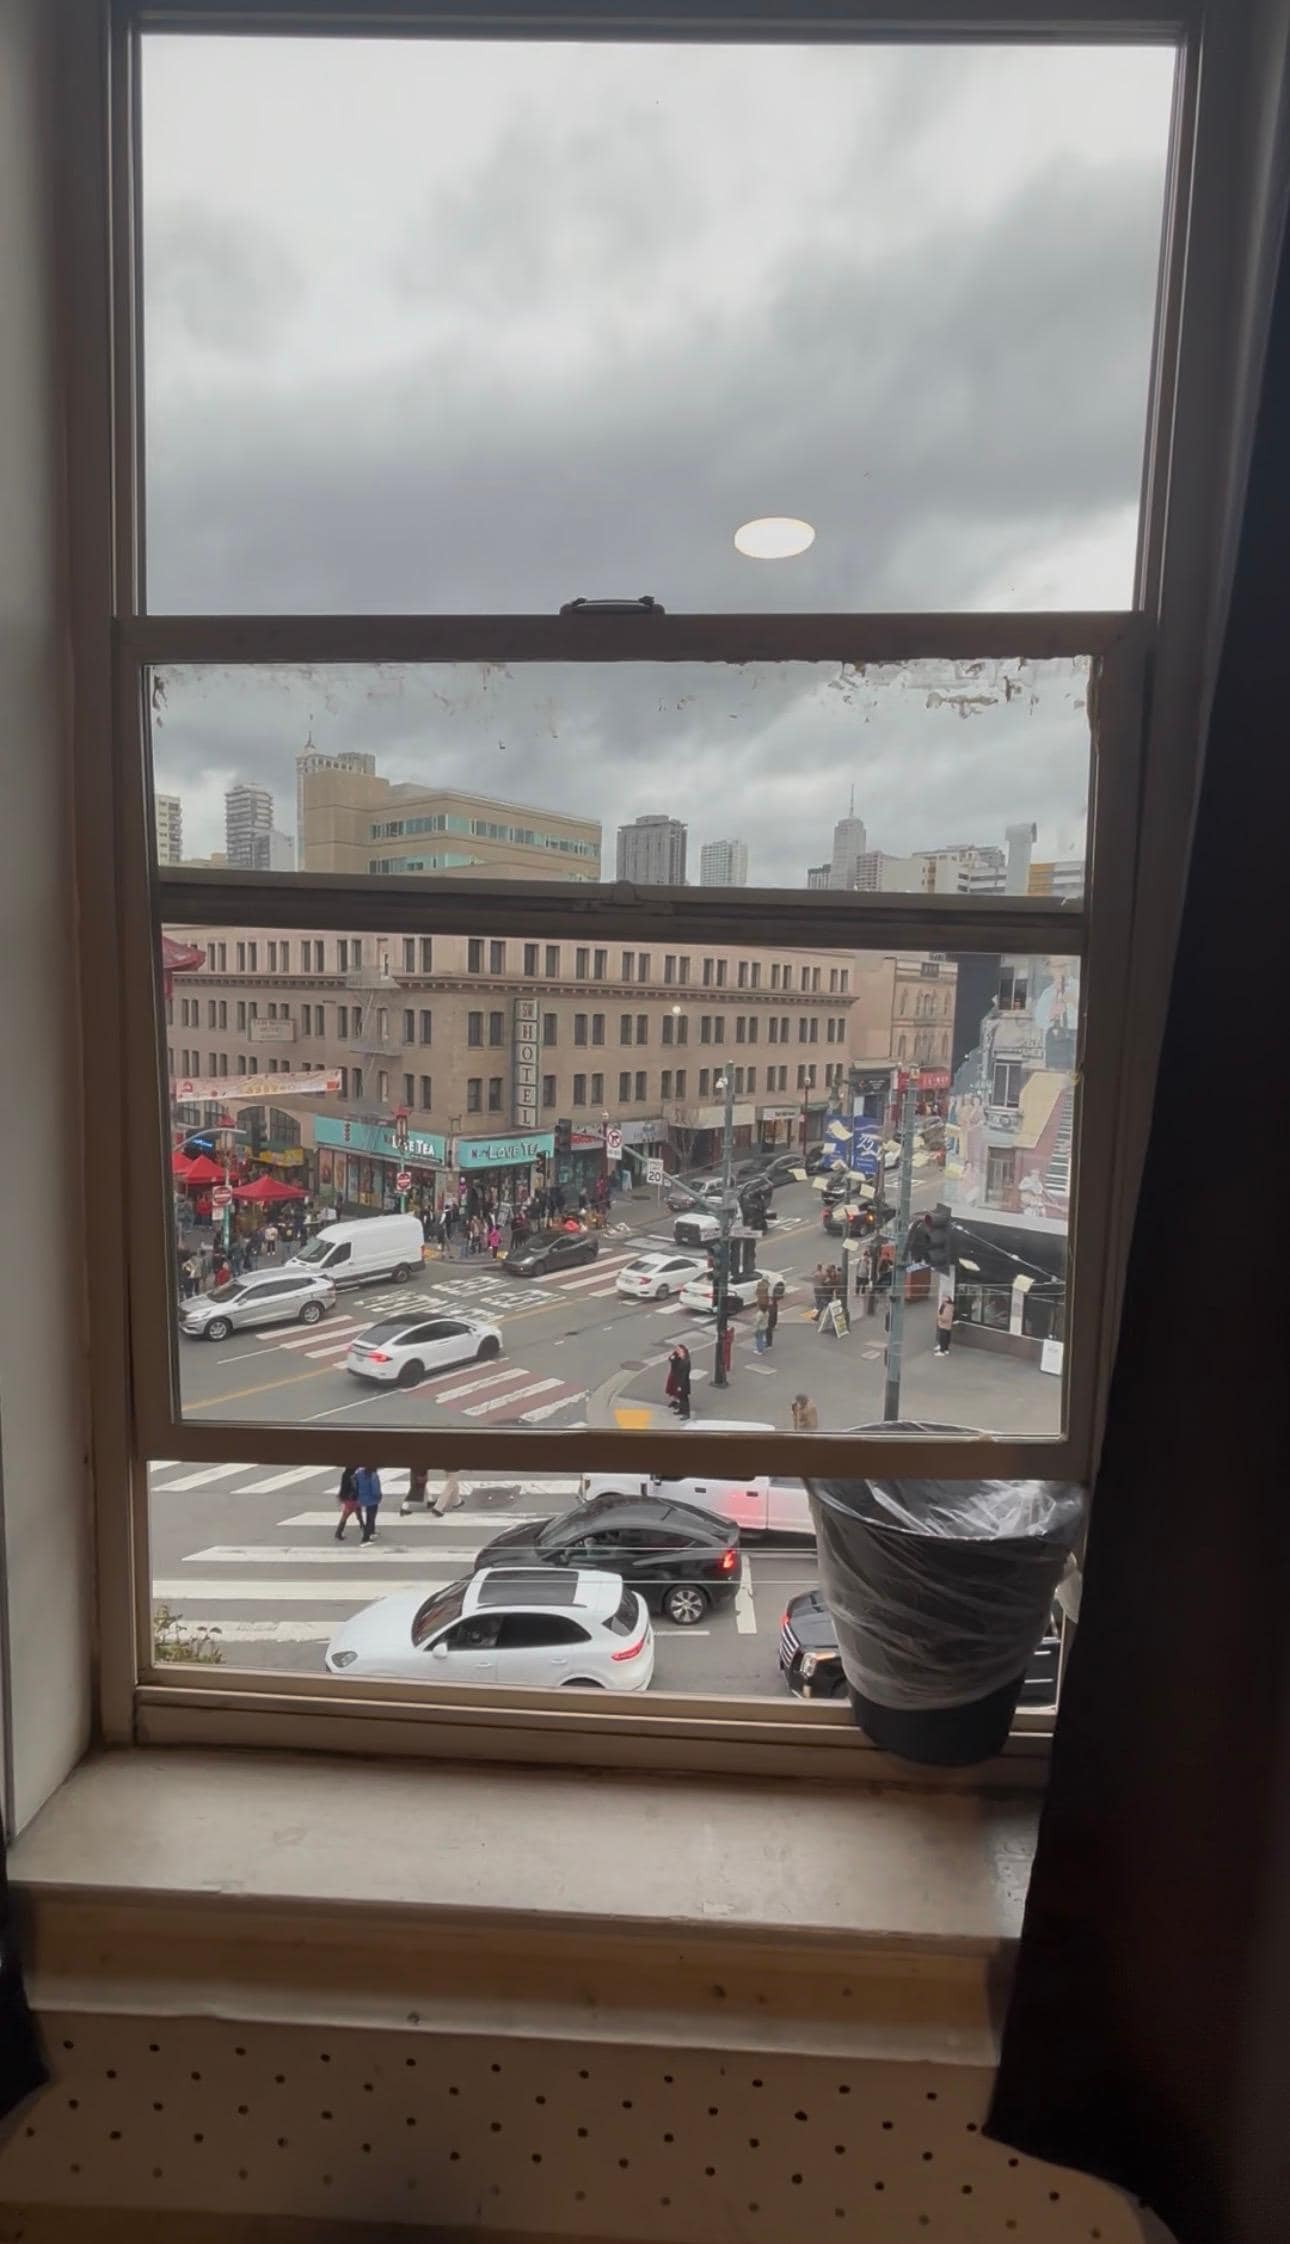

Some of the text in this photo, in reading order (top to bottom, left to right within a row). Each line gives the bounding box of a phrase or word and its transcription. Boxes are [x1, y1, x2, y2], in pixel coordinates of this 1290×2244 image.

[521, 1024, 534, 1125] HOTEL
[416, 1140, 435, 1155] TEA
[488, 1145, 519, 1161] LOVE
[648, 1171, 661, 1183] 20
